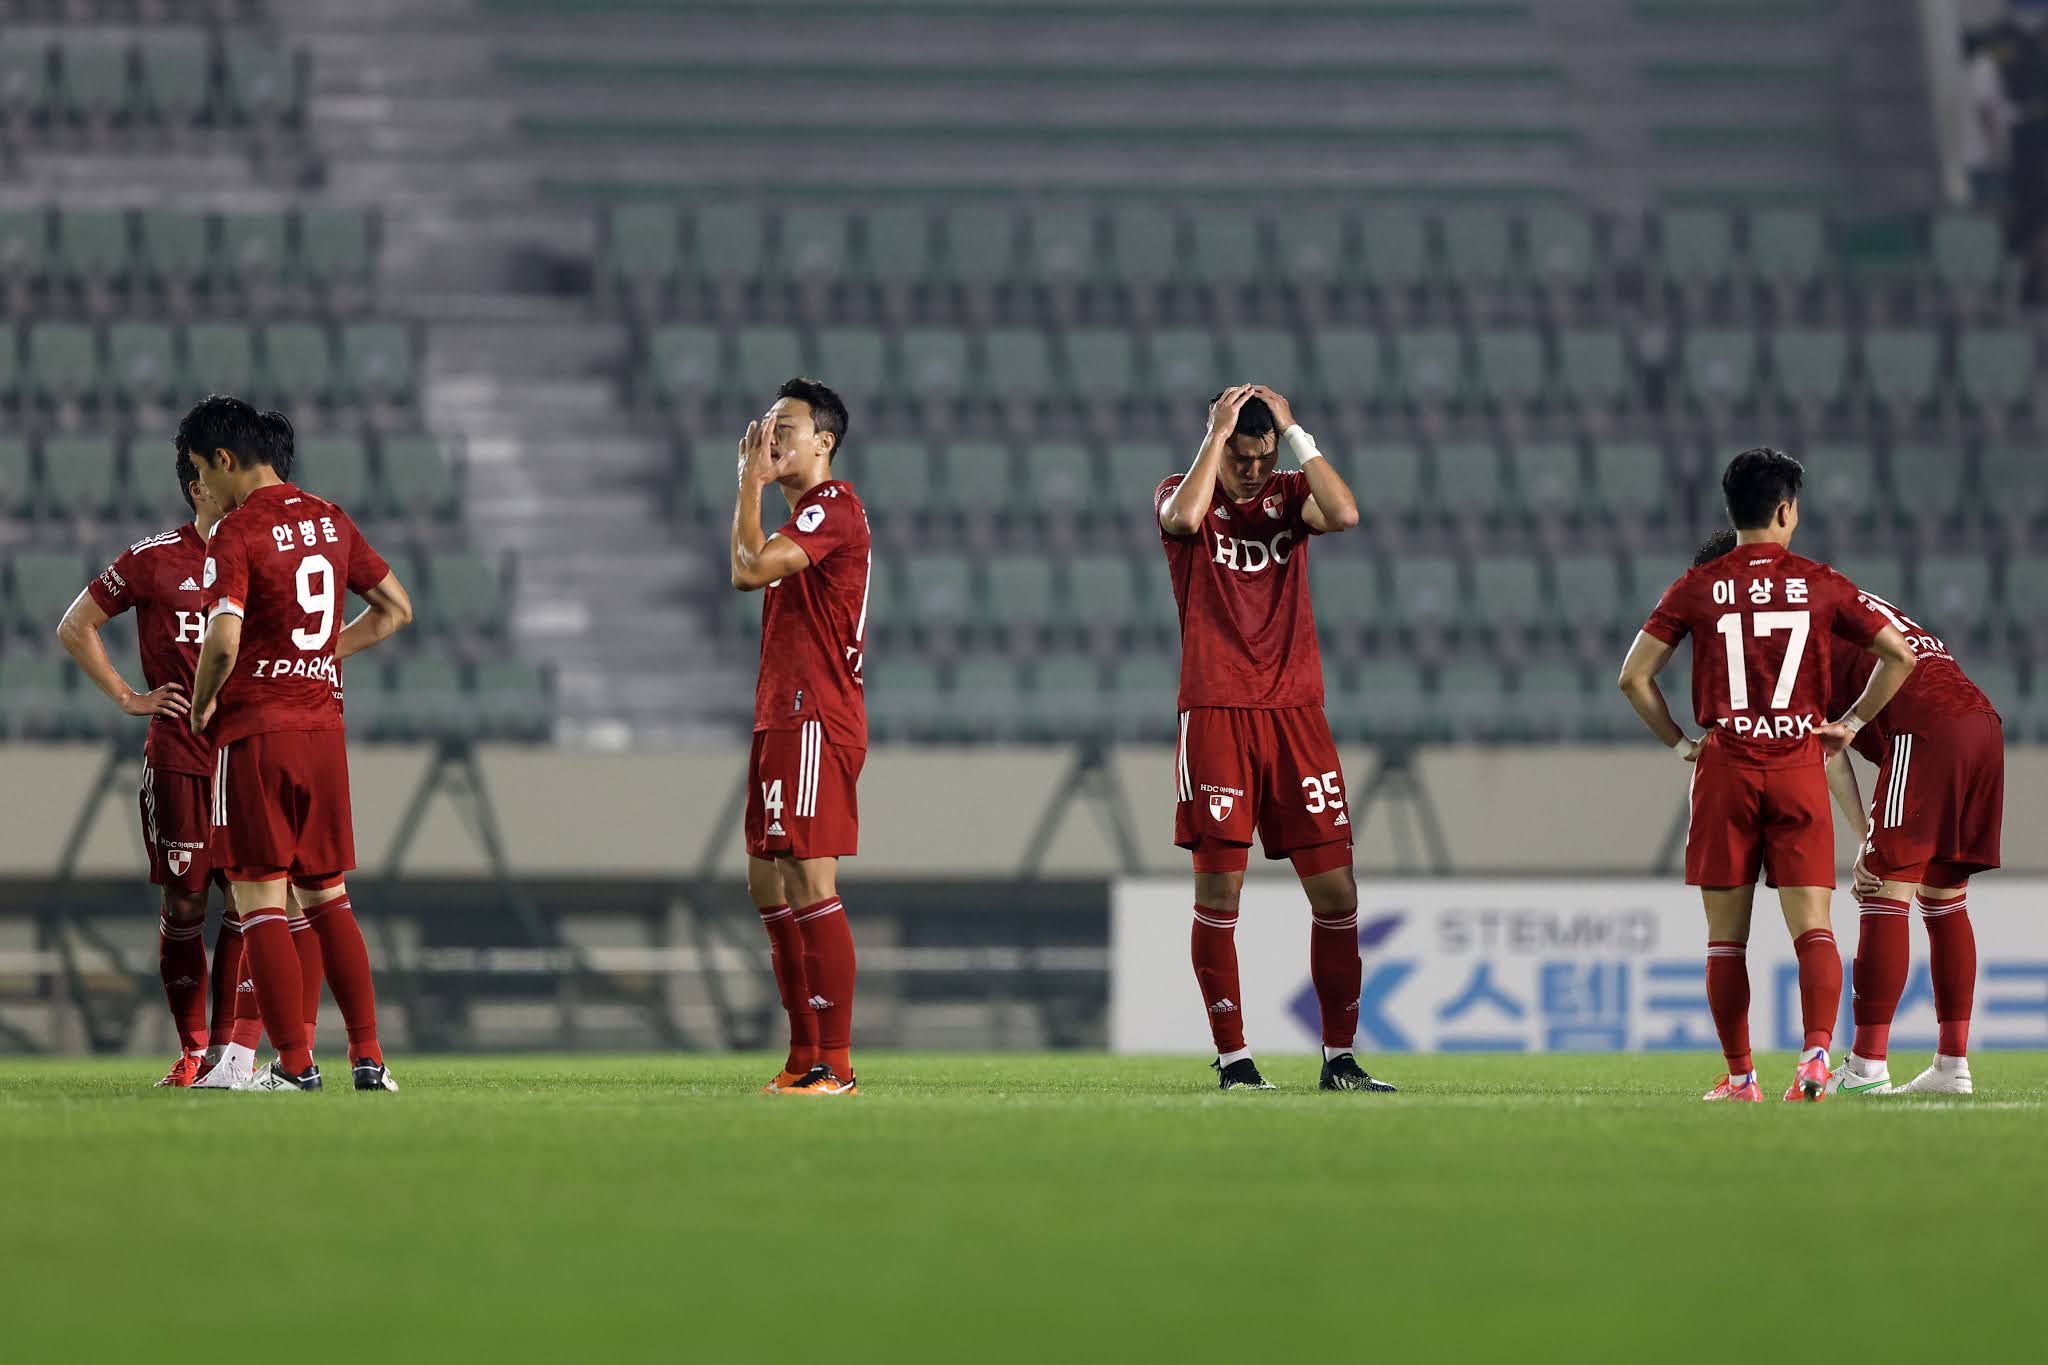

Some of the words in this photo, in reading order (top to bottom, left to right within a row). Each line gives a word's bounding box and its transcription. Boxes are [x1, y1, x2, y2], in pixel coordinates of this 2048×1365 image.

[1212, 528, 1293, 572] HDC
[291, 553, 335, 651] 9
[1716, 611, 1810, 710] 17
[1200, 784, 1219, 792] HDC
[1301, 770, 1344, 814] 35
